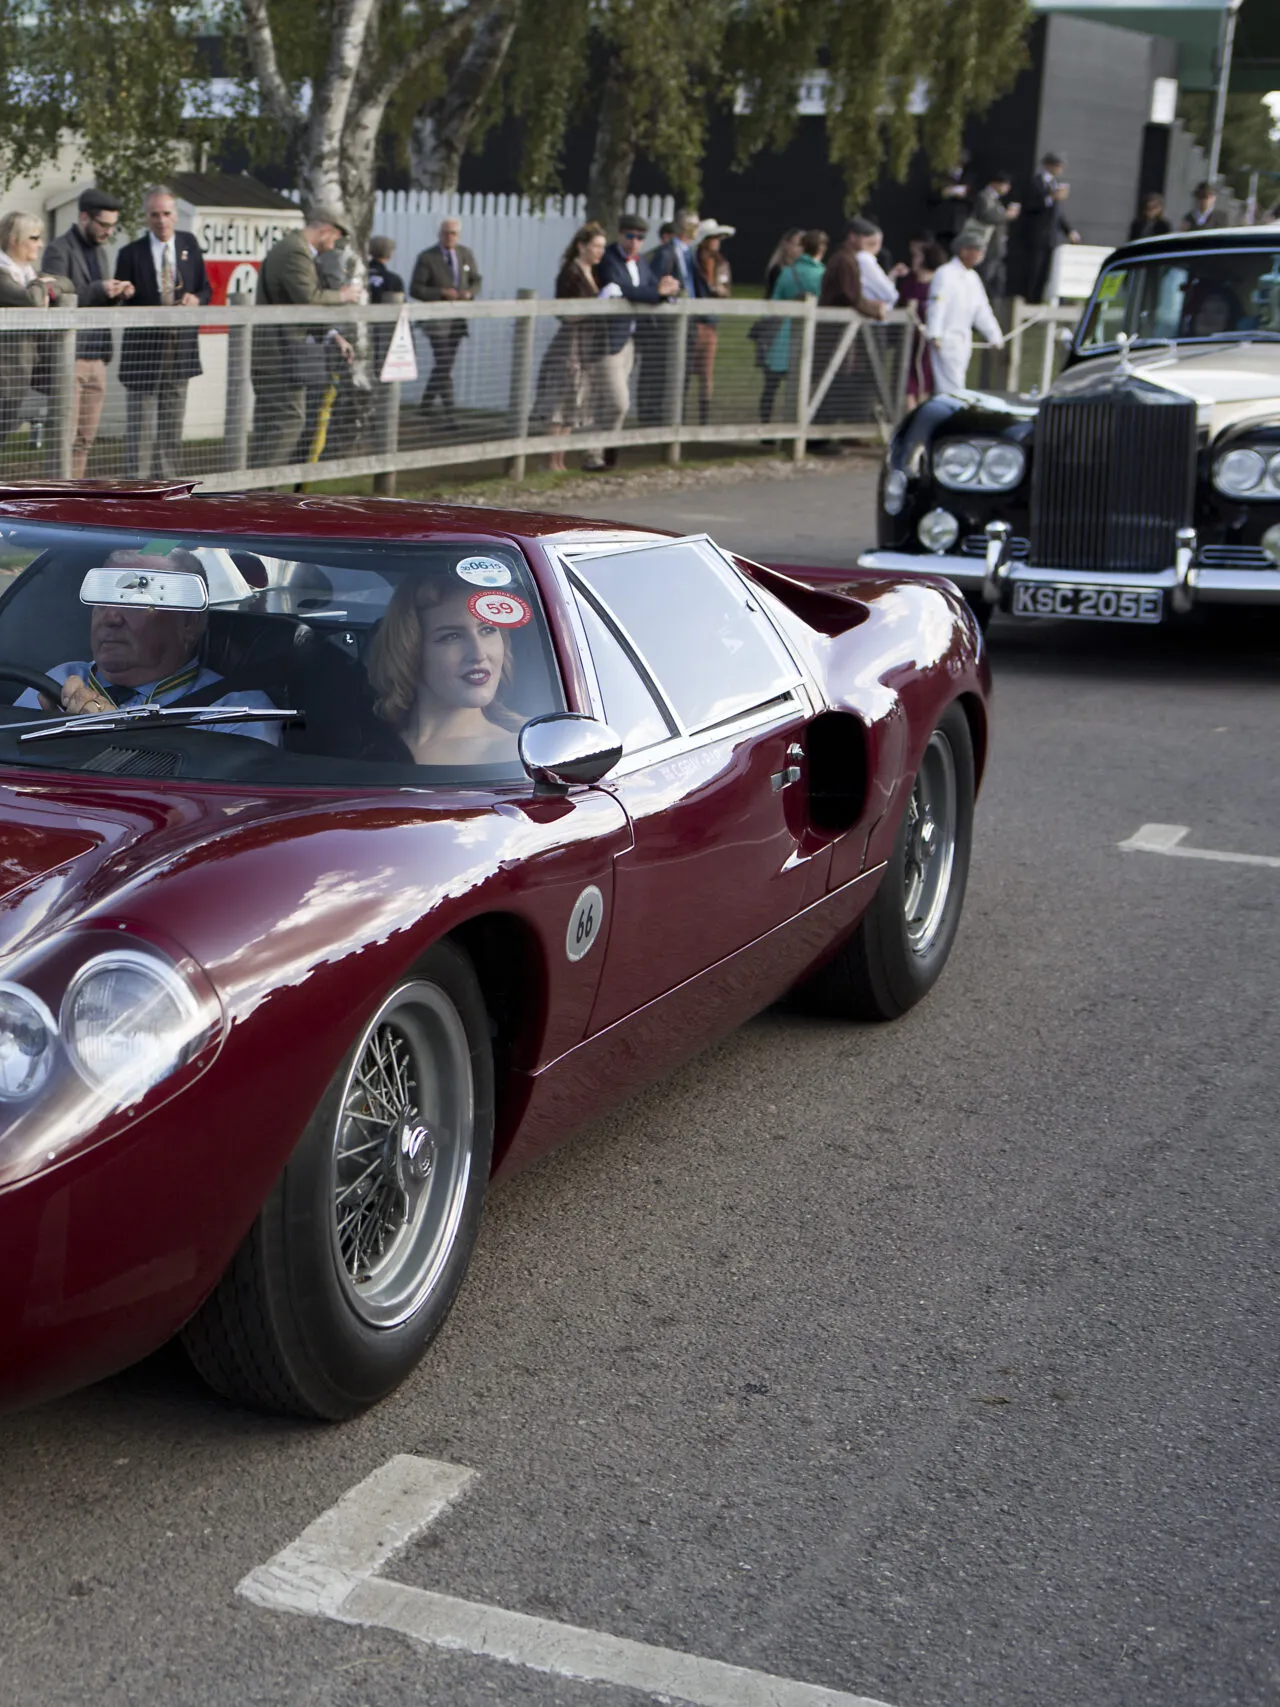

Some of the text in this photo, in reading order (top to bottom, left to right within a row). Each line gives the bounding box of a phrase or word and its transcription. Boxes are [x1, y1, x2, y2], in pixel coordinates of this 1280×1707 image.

[486, 602, 514, 615] 59
[1019, 586, 1157, 618] KSC 205E
[576, 903, 593, 944] 66
